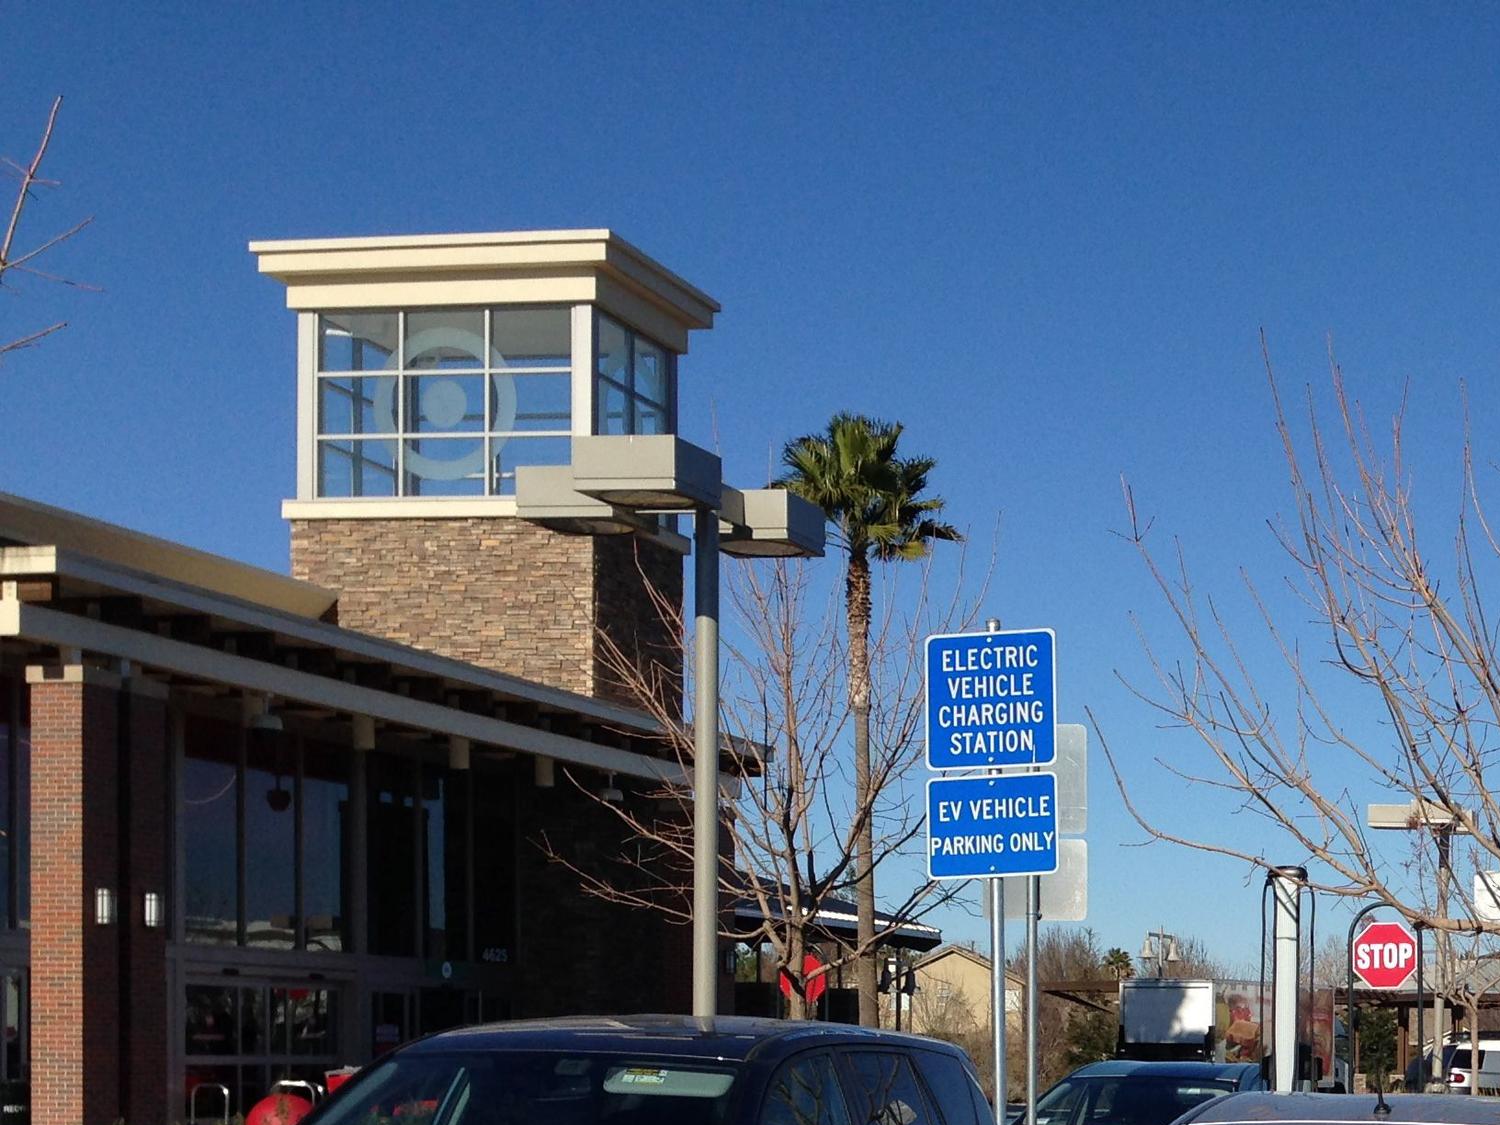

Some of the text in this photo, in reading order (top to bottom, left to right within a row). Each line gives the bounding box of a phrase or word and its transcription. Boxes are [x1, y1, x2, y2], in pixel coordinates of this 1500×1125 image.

[941, 644, 1038, 672] ELECTRIC
[947, 673, 1034, 699] VEHICLE
[938, 701, 1043, 728] CHARGING
[950, 730, 1033, 755] STATION
[938, 796, 1050, 822] EV VEHICLE
[931, 831, 1054, 857] PARKING ONLY
[1356, 942, 1413, 970] STOP
